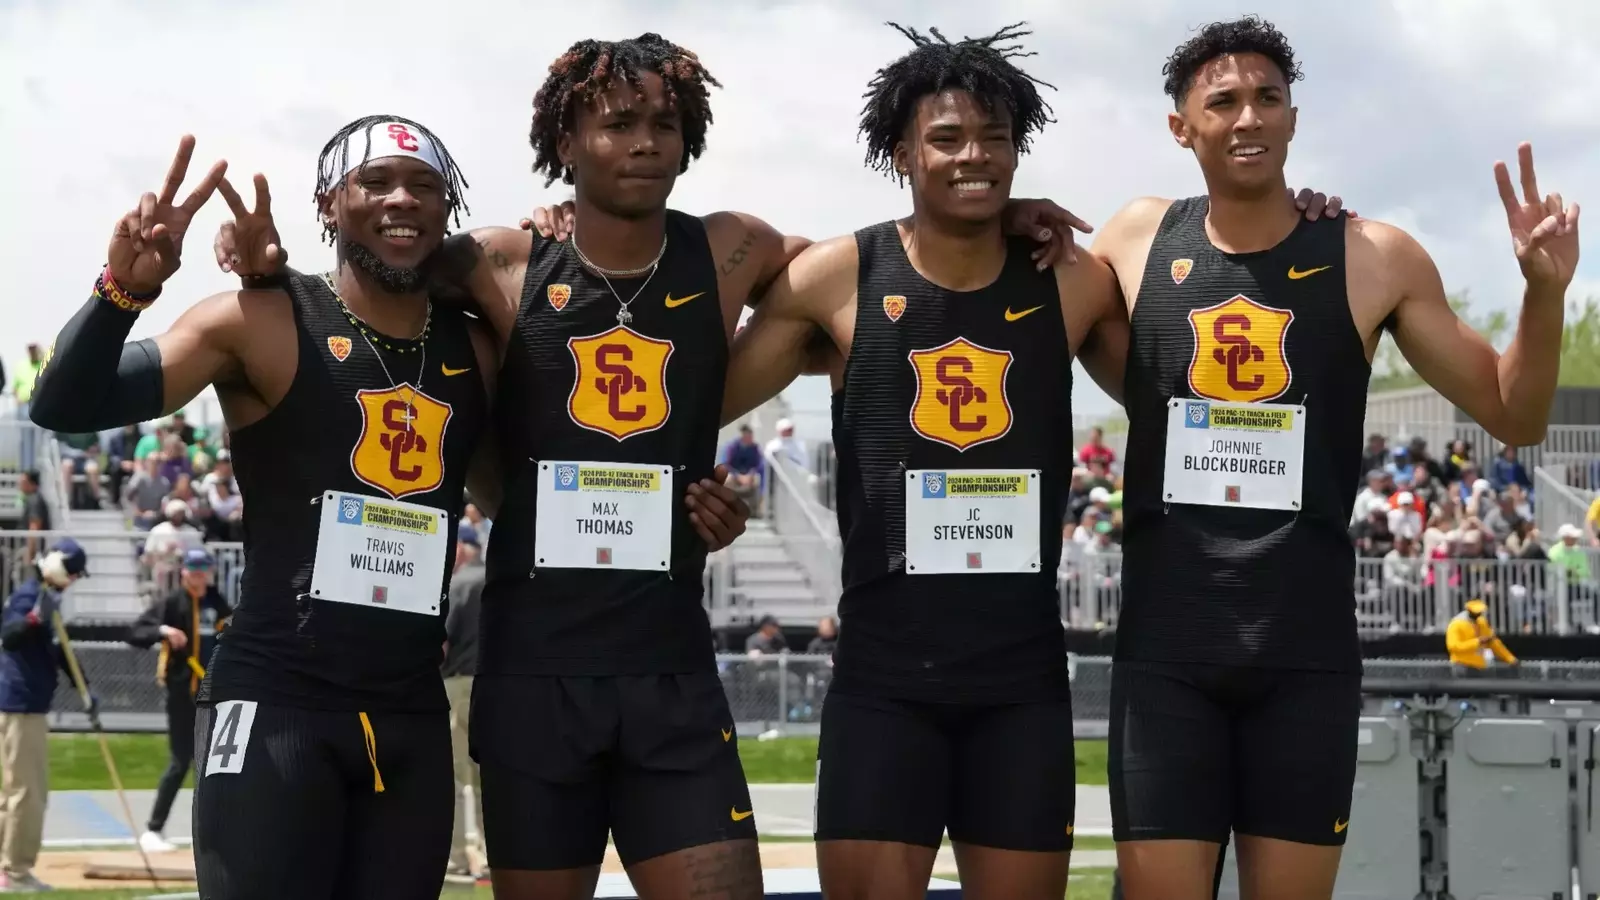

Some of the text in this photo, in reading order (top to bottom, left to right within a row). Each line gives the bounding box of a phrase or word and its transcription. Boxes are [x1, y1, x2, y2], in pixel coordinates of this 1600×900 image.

[388, 124, 419, 152] SC
[1213, 314, 1264, 391] SC
[595, 343, 647, 421] SC
[936, 356, 987, 432] SC
[1214, 415, 1283, 428] CHAMPIONSHIPS
[380, 399, 427, 482] SC
[1209, 440, 1262, 456] JOHNNIE
[1184, 455, 1286, 476] BLOCKBURGER
[583, 477, 650, 488] CHAMPIONSHIPS
[951, 483, 1018, 493] CHAMPIONSHIPS
[397, 510, 414, 519] TRACK
[592, 502, 619, 516] MAX
[966, 507, 980, 521] JC
[367, 512, 429, 531] CHAMPIONSHIPS
[576, 519, 633, 536] THOMAS
[934, 524, 1013, 540] STEVENSON
[366, 537, 405, 556] TRAVIS
[350, 553, 414, 577] WILLIAMS
[212, 703, 244, 768] 4
